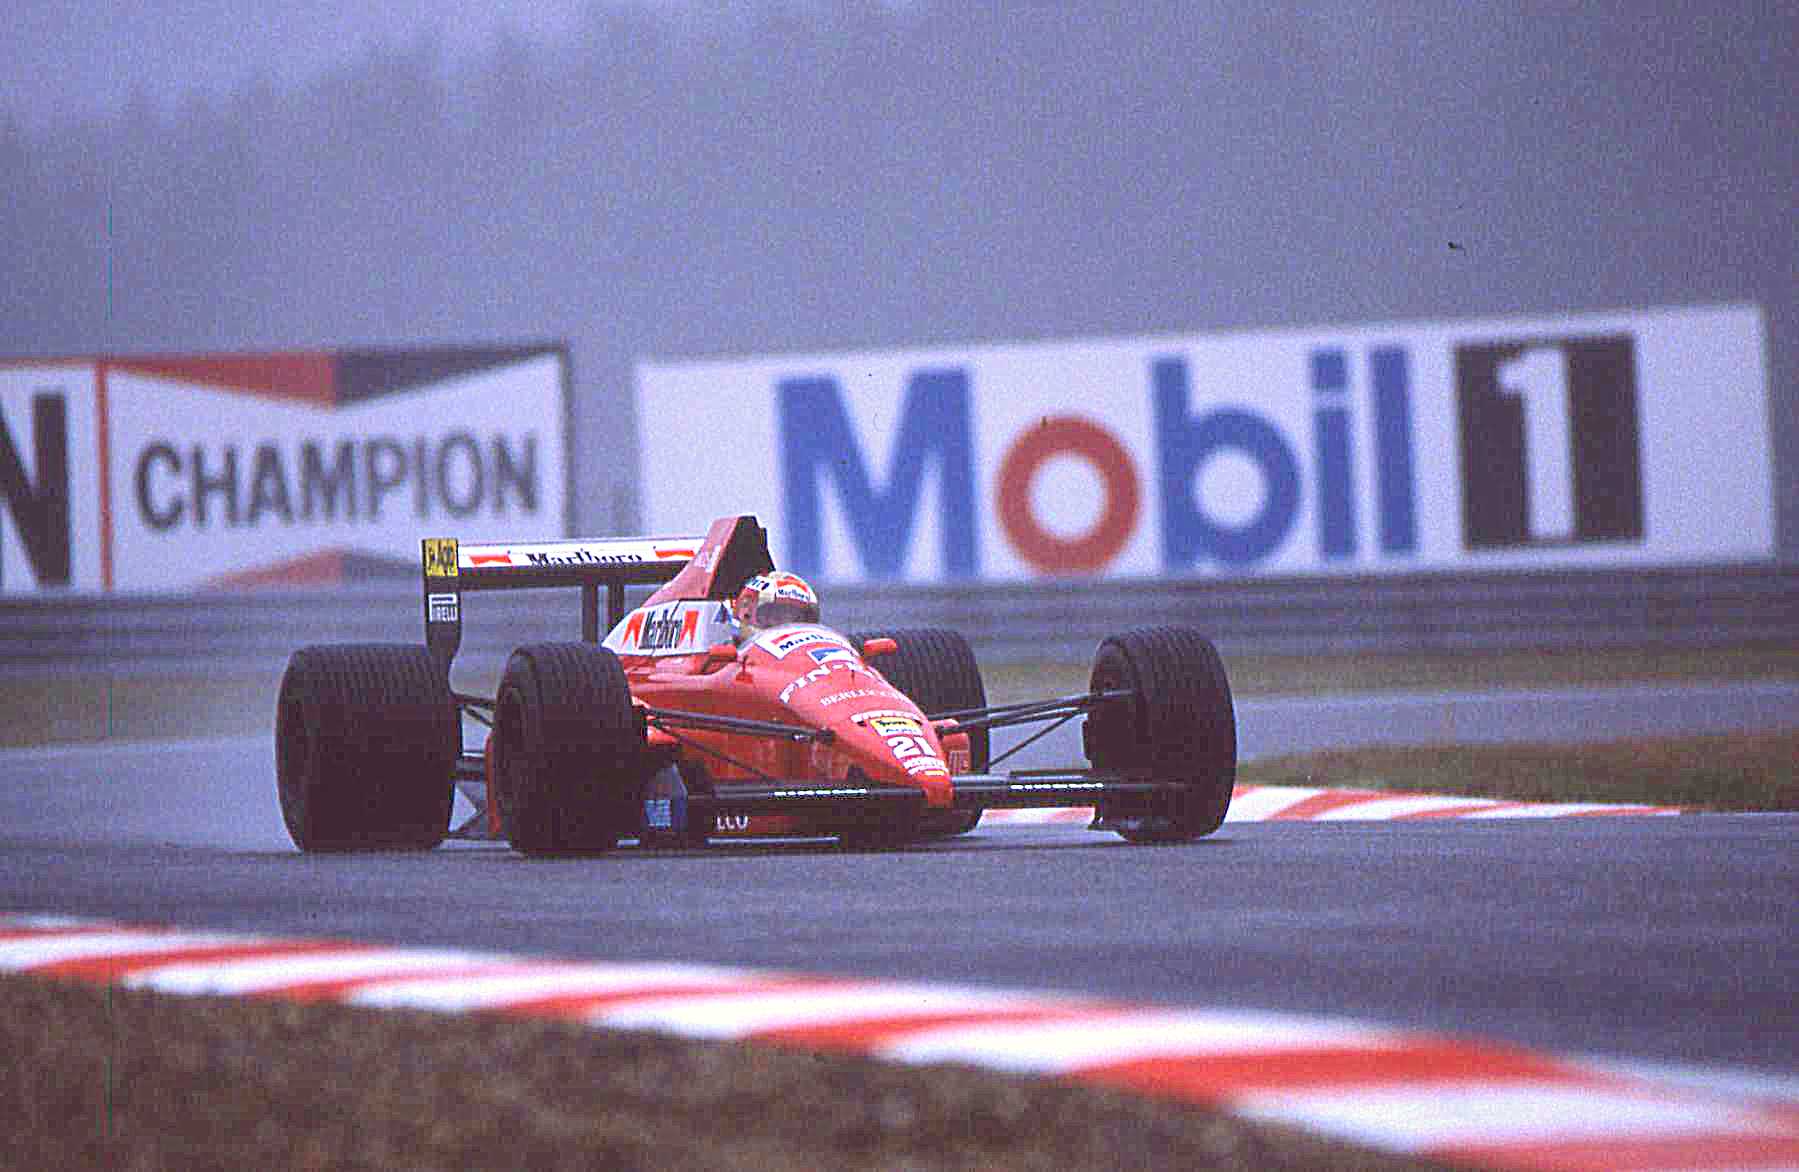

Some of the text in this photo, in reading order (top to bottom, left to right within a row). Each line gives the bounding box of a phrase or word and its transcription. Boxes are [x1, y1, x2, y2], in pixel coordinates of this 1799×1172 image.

[134, 430, 538, 532] CHAMPION
[774, 343, 1578, 580] Mobil 1
[526, 547, 642, 568] Marlboro
[886, 735, 937, 760] 21
